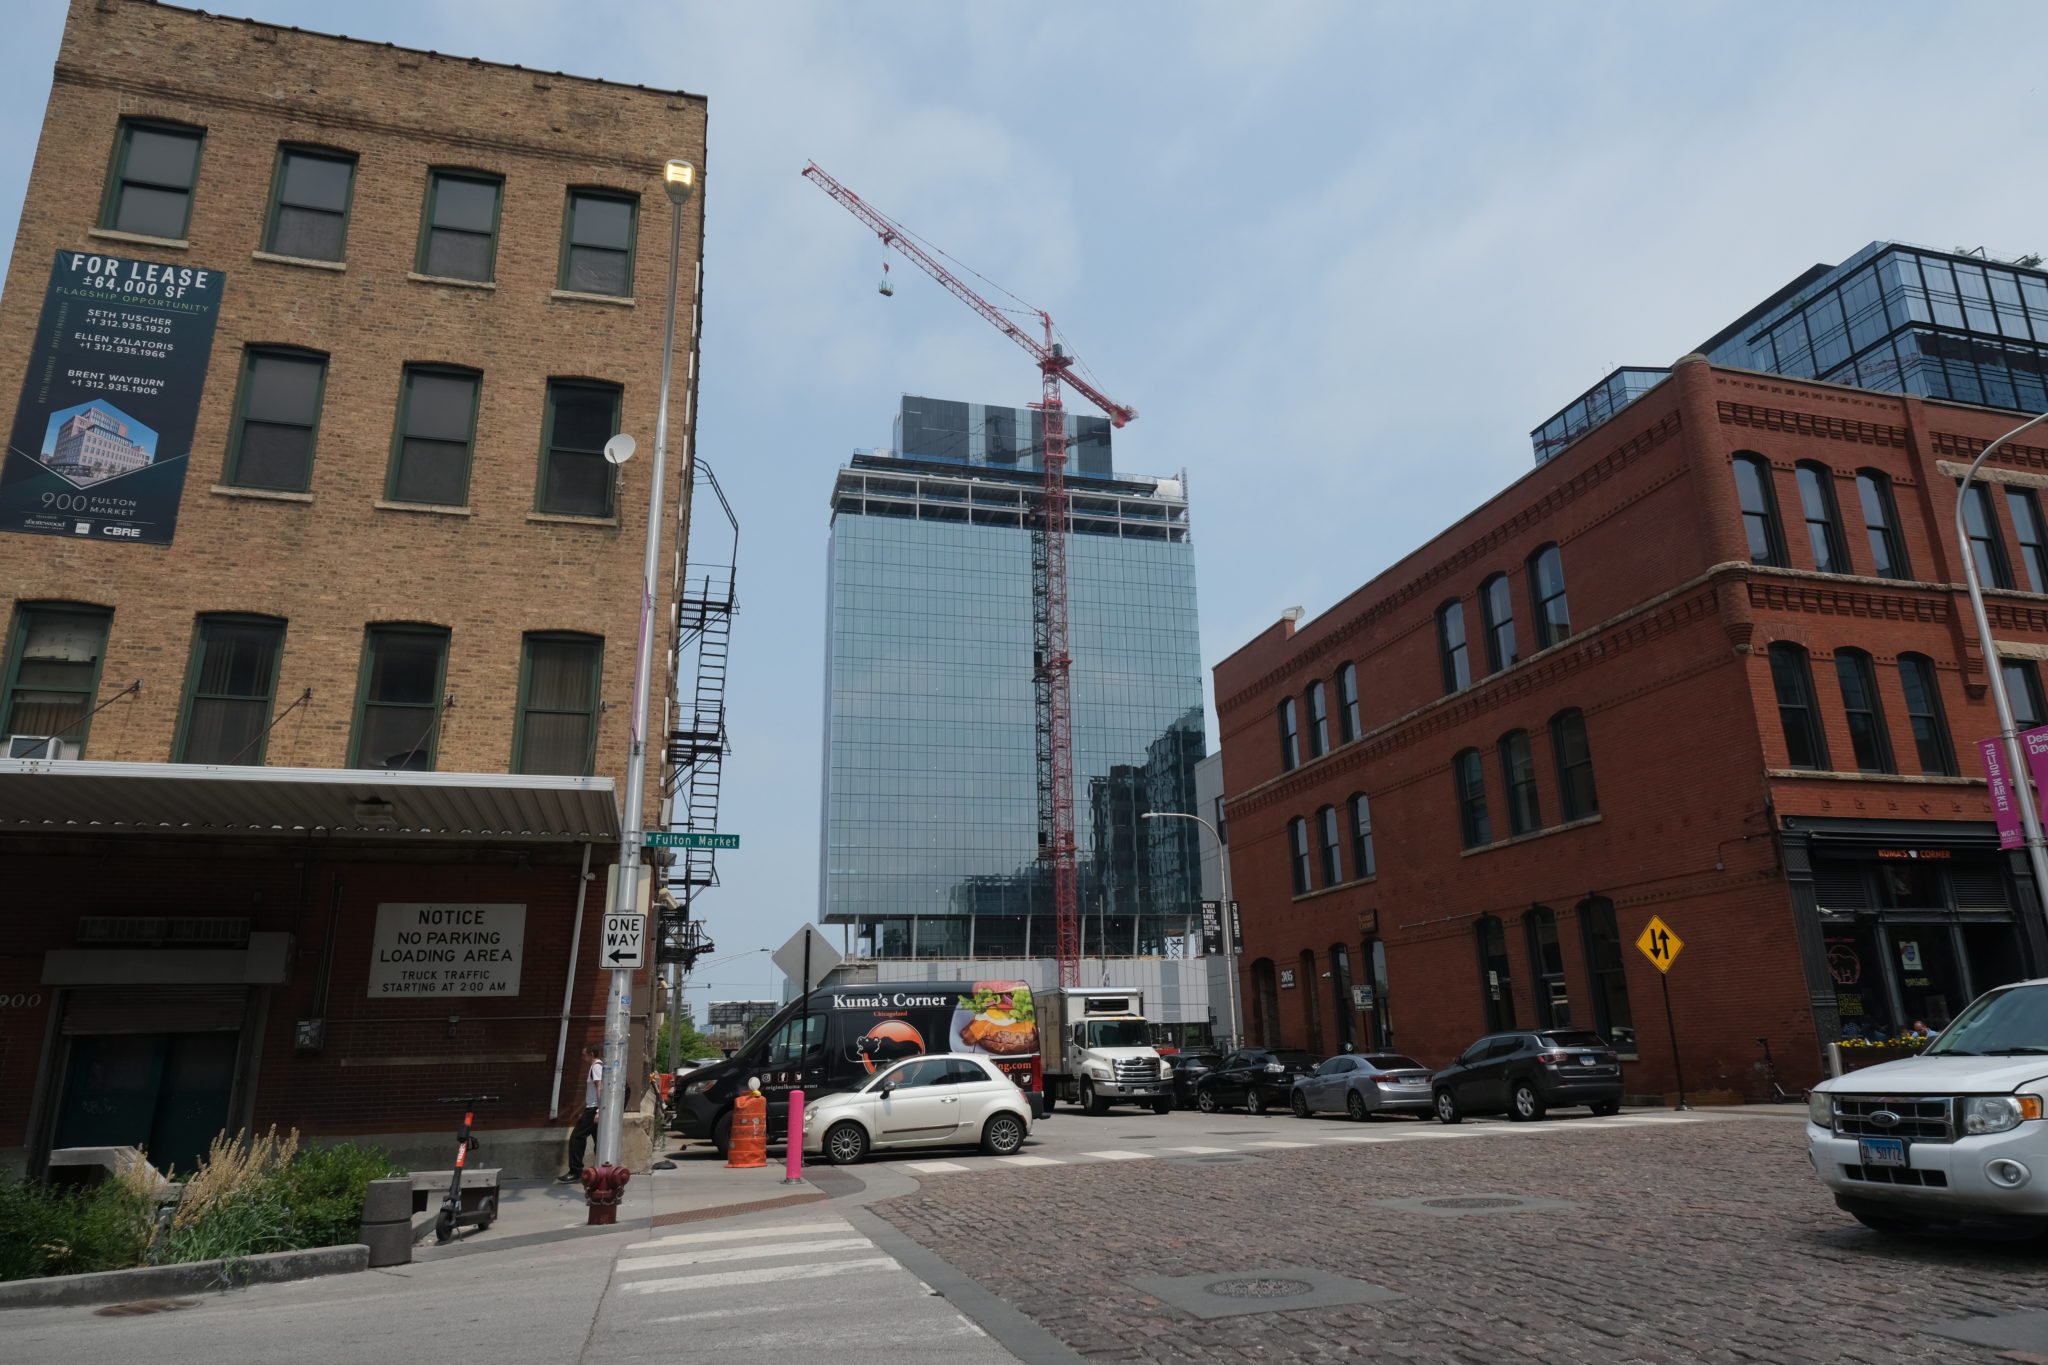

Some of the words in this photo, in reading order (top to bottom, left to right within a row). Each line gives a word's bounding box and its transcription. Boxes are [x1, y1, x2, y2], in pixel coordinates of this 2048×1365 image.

[71, 254, 120, 277] FOR
[131, 262, 209, 289] LEASE
[82, 275, 157, 296] ±64,000
[165, 285, 186, 299] SF
[56, 286, 117, 300] FLAGSHIP
[122, 295, 209, 312] OPPORTUNITY
[88, 308, 117, 319] SETH
[121, 312, 172, 326] TUSCHER
[86, 317, 96, 325] +1
[99, 318, 171, 334] 312.935.1920
[74, 332, 110, 343] ELLEN
[112, 336, 175, 351] ZALATORIS
[94, 343, 166, 358] 312.935.1966
[67, 369, 106, 380] BRENT
[109, 374, 165, 387] WAYBURN
[85, 380, 158, 395] 312.935.1906
[41, 492, 87, 512] 900
[91, 496, 137, 507] FULTON
[89, 506, 136, 516] MARKET
[103, 526, 141, 537] CBRE
[1984, 743, 2000, 776] FULTON
[1992, 778, 2009, 812] MARKET
[655, 834, 692, 846] Fulton
[698, 835, 737, 847] Market
[418, 910, 485, 925] NOTICE
[608, 918, 640, 931] ONE
[397, 932, 422, 945] NO
[426, 932, 501, 945] PARKING
[607, 934, 640, 946] WAY
[380, 949, 455, 963] LOADING
[463, 949, 513, 962] AREA
[402, 971, 438, 980] TRUCK
[444, 970, 490, 980] TRAFFIC
[382, 982, 436, 992] STARTING
[441, 982, 454, 991] AT
[460, 982, 484, 992] 2:00
[489, 982, 506, 991] AM
[0, 993, 41, 1008] 900
[832, 993, 889, 1008] Kuma's
[893, 993, 947, 1007] Corner
